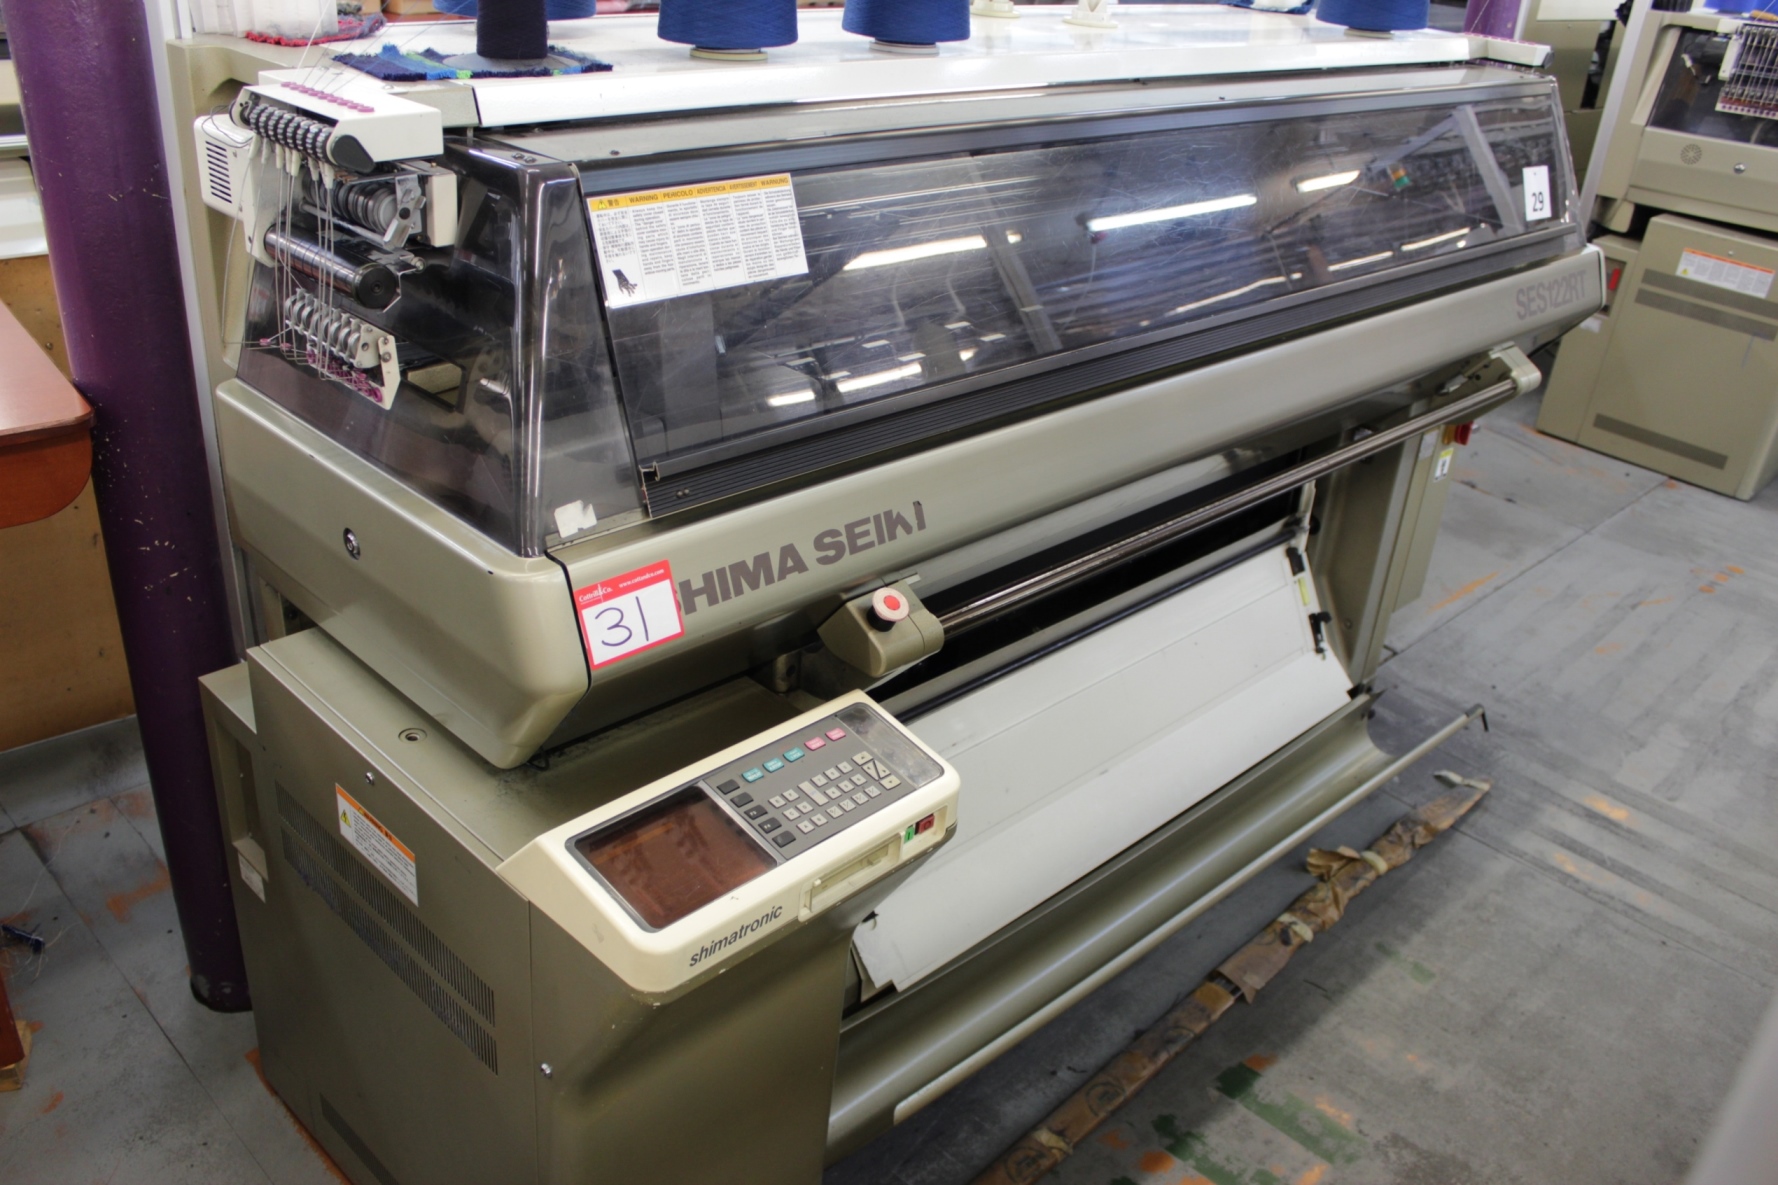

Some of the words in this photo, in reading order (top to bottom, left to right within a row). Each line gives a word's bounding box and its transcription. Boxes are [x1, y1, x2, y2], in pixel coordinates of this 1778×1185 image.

[697, 185, 726, 195] ADVERTENCIA
[760, 177, 789, 187] WARNUNG
[629, 193, 659, 204] WARNING
[662, 189, 694, 199] PERICOLO
[1532, 191, 1545, 212] 29
[1516, 269, 1587, 321] SES122RT
[677, 543, 809, 615] HIMA
[595, 596, 649, 647] 31
[689, 905, 783, 967] shimatronic
